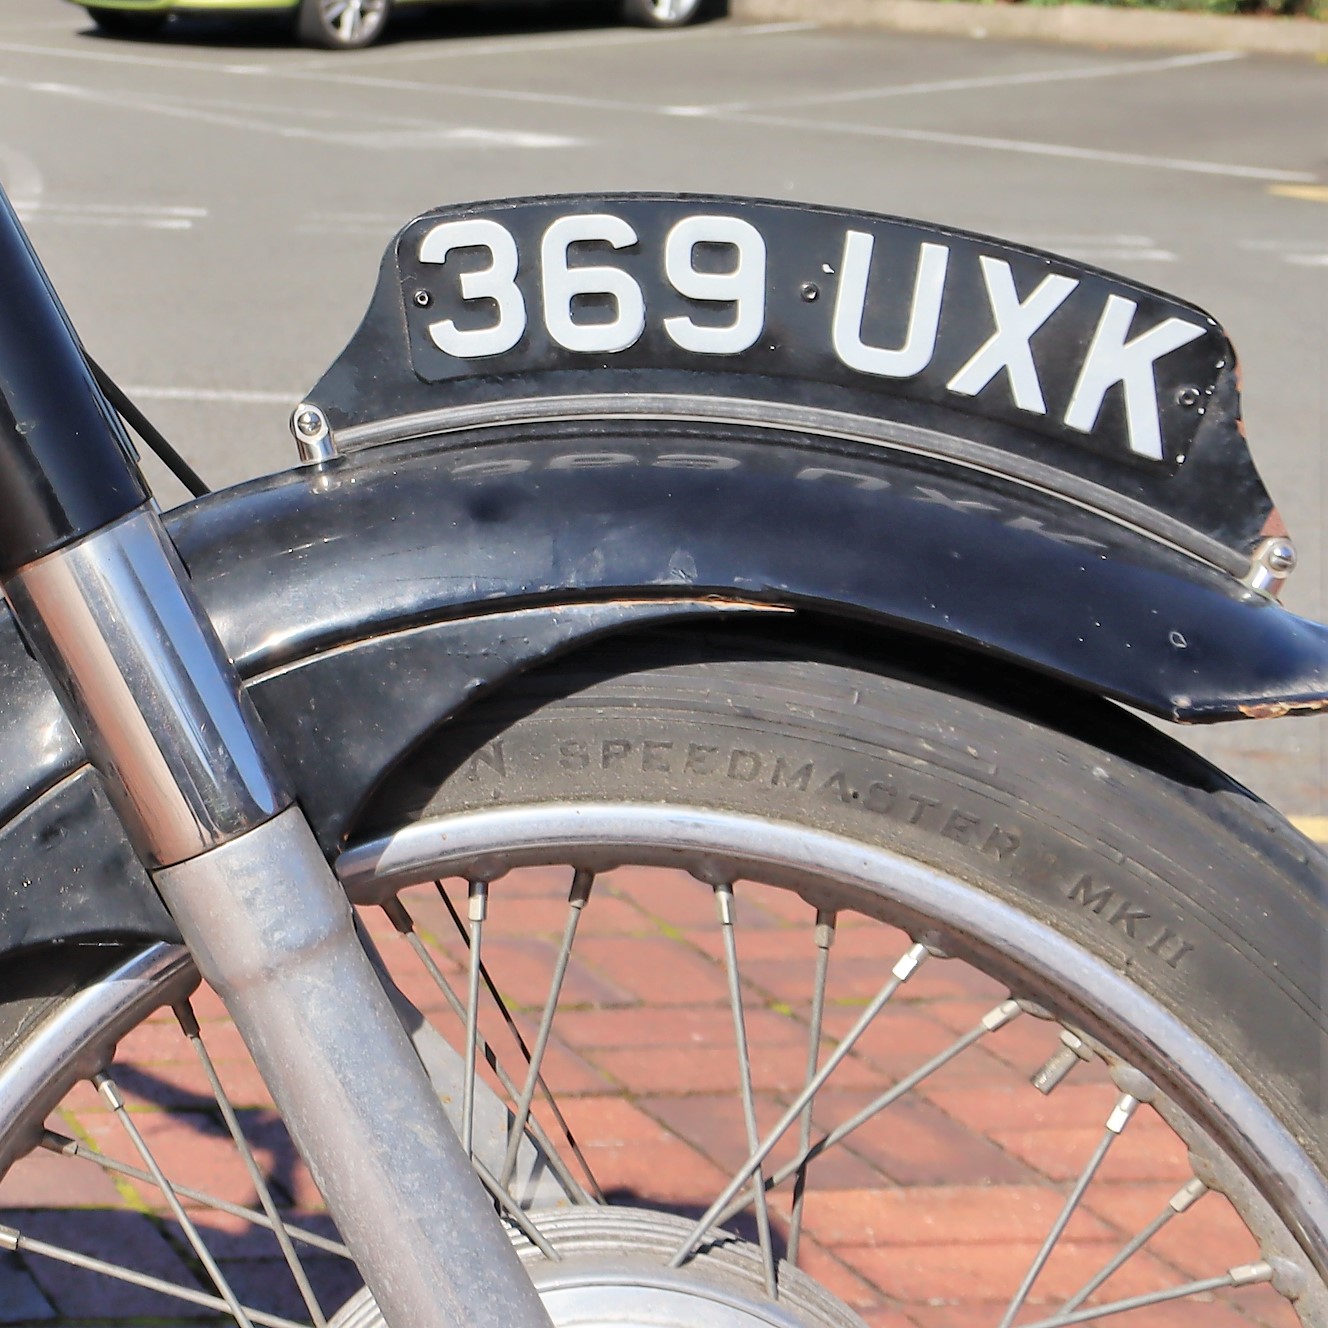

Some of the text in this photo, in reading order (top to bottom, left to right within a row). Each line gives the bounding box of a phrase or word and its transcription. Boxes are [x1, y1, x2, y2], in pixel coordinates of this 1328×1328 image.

[417, 213, 1208, 461] 369 UXK
[558, 737, 1022, 861] SPEEDMASTER
